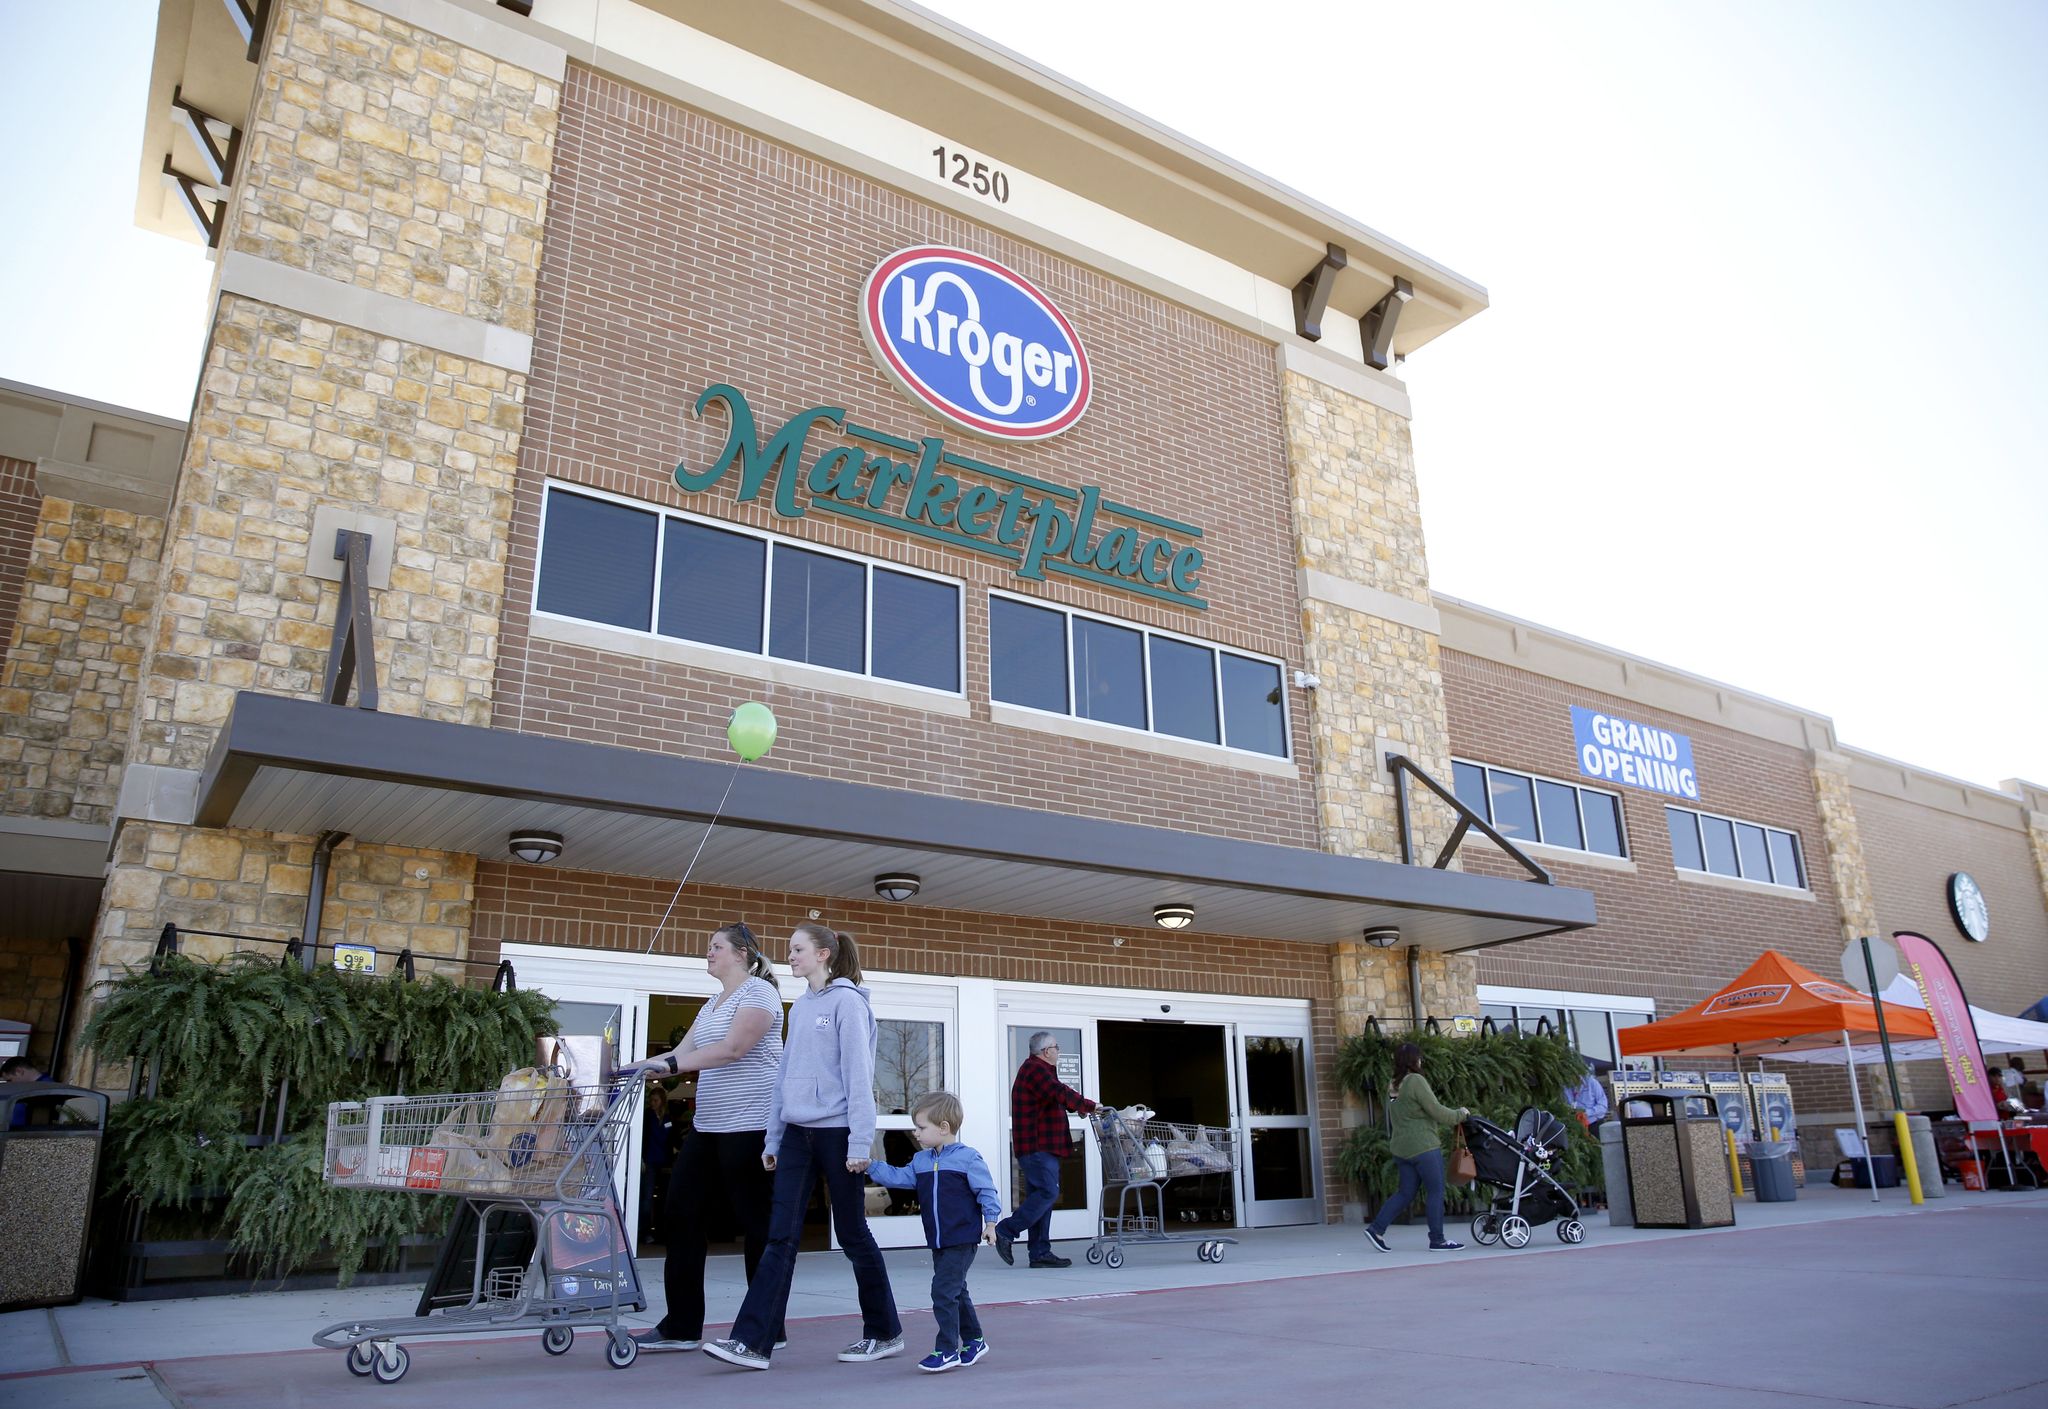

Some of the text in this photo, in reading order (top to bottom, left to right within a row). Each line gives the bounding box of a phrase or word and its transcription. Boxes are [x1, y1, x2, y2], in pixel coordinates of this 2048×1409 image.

[933, 146, 1009, 203] 1250
[901, 271, 1073, 415] Kroger
[671, 383, 1203, 593] Marketplace
[1592, 714, 1677, 761] GRAND
[1583, 744, 1697, 797] OPENING
